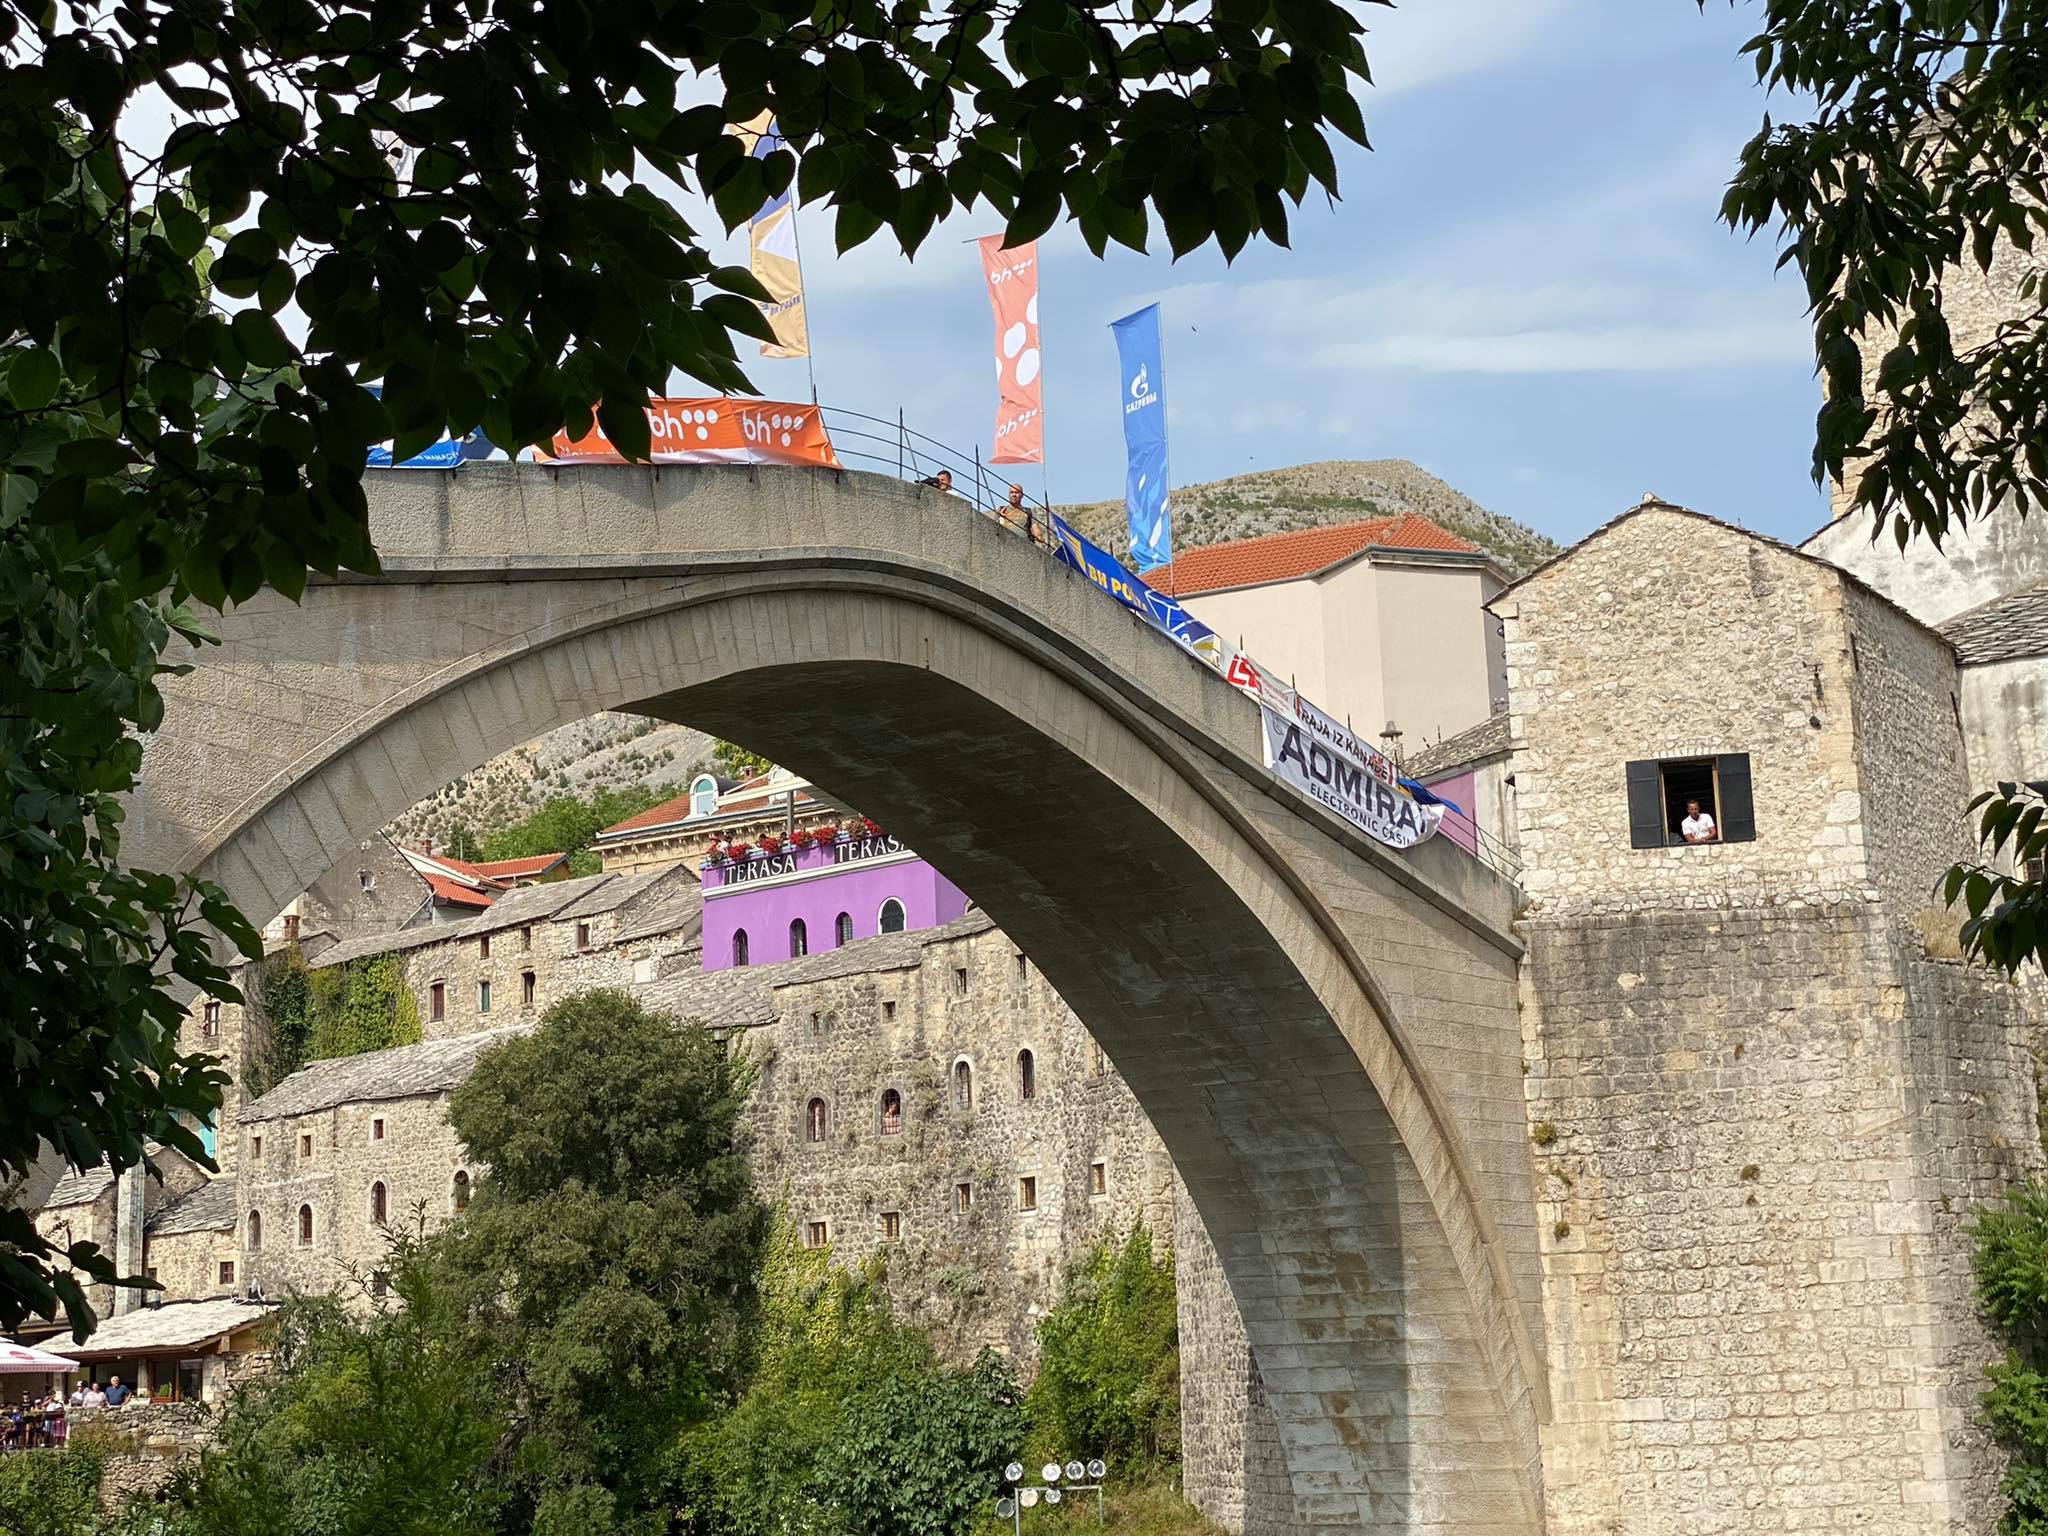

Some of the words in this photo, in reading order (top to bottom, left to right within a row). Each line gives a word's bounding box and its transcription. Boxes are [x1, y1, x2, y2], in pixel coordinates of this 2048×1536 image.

[1126, 391, 1157, 415] GAZPROM
[1087, 563, 1108, 590] BH
[1301, 708, 1331, 740] RAJA
[1332, 729, 1344, 749] IZ
[1345, 738, 1389, 781] KANADE
[1310, 782, 1379, 833] ELECTRONIC
[836, 834, 905, 864] TERAS
[725, 853, 797, 885] TERASA
